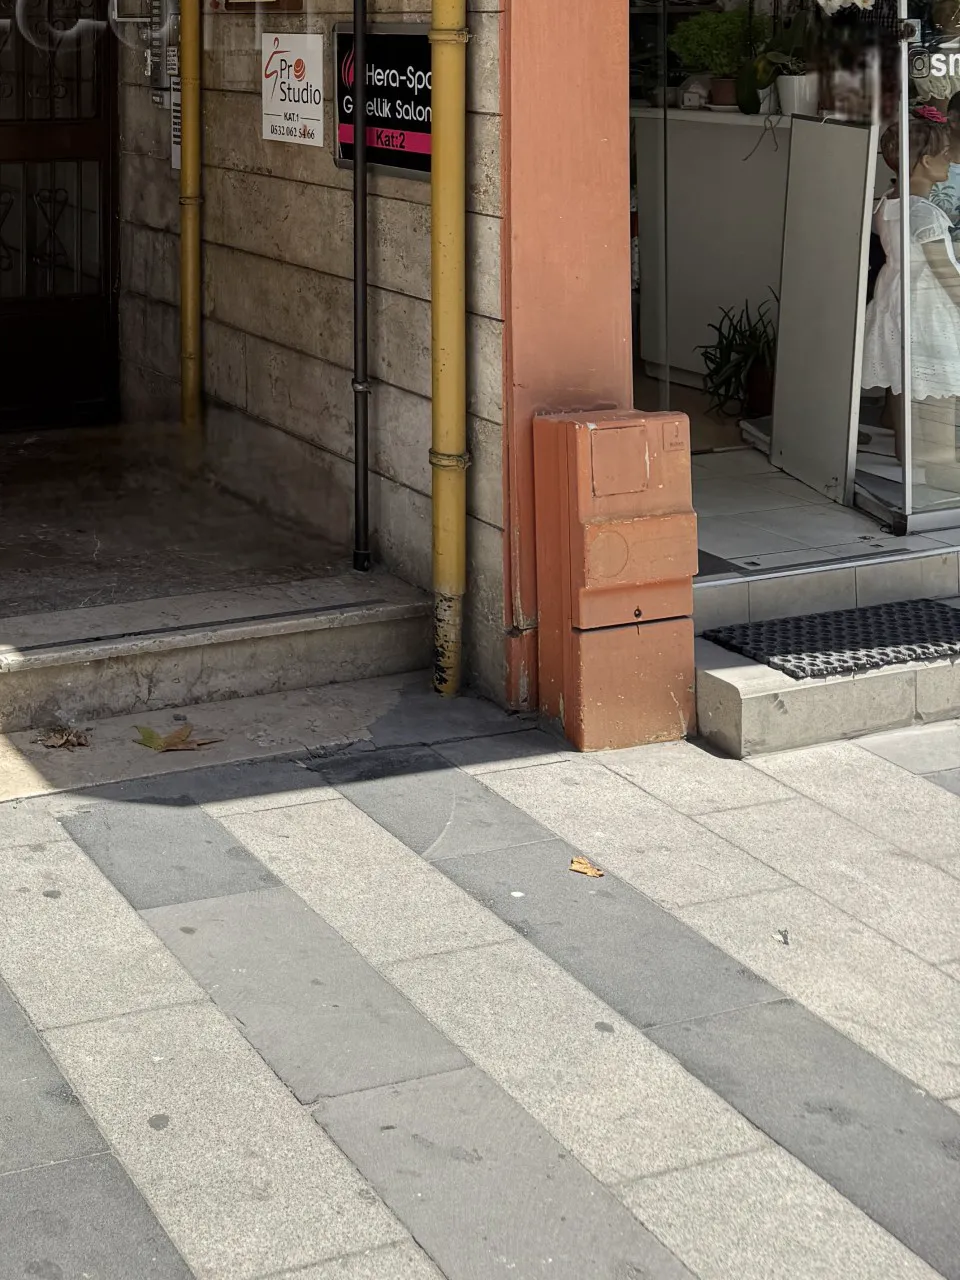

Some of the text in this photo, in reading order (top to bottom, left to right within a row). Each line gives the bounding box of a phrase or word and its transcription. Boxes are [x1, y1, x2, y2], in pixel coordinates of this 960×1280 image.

[279, 81, 322, 105] Studio
[343, 95, 392, 118] Gellik
[375, 129, 406, 149] Kat:2
